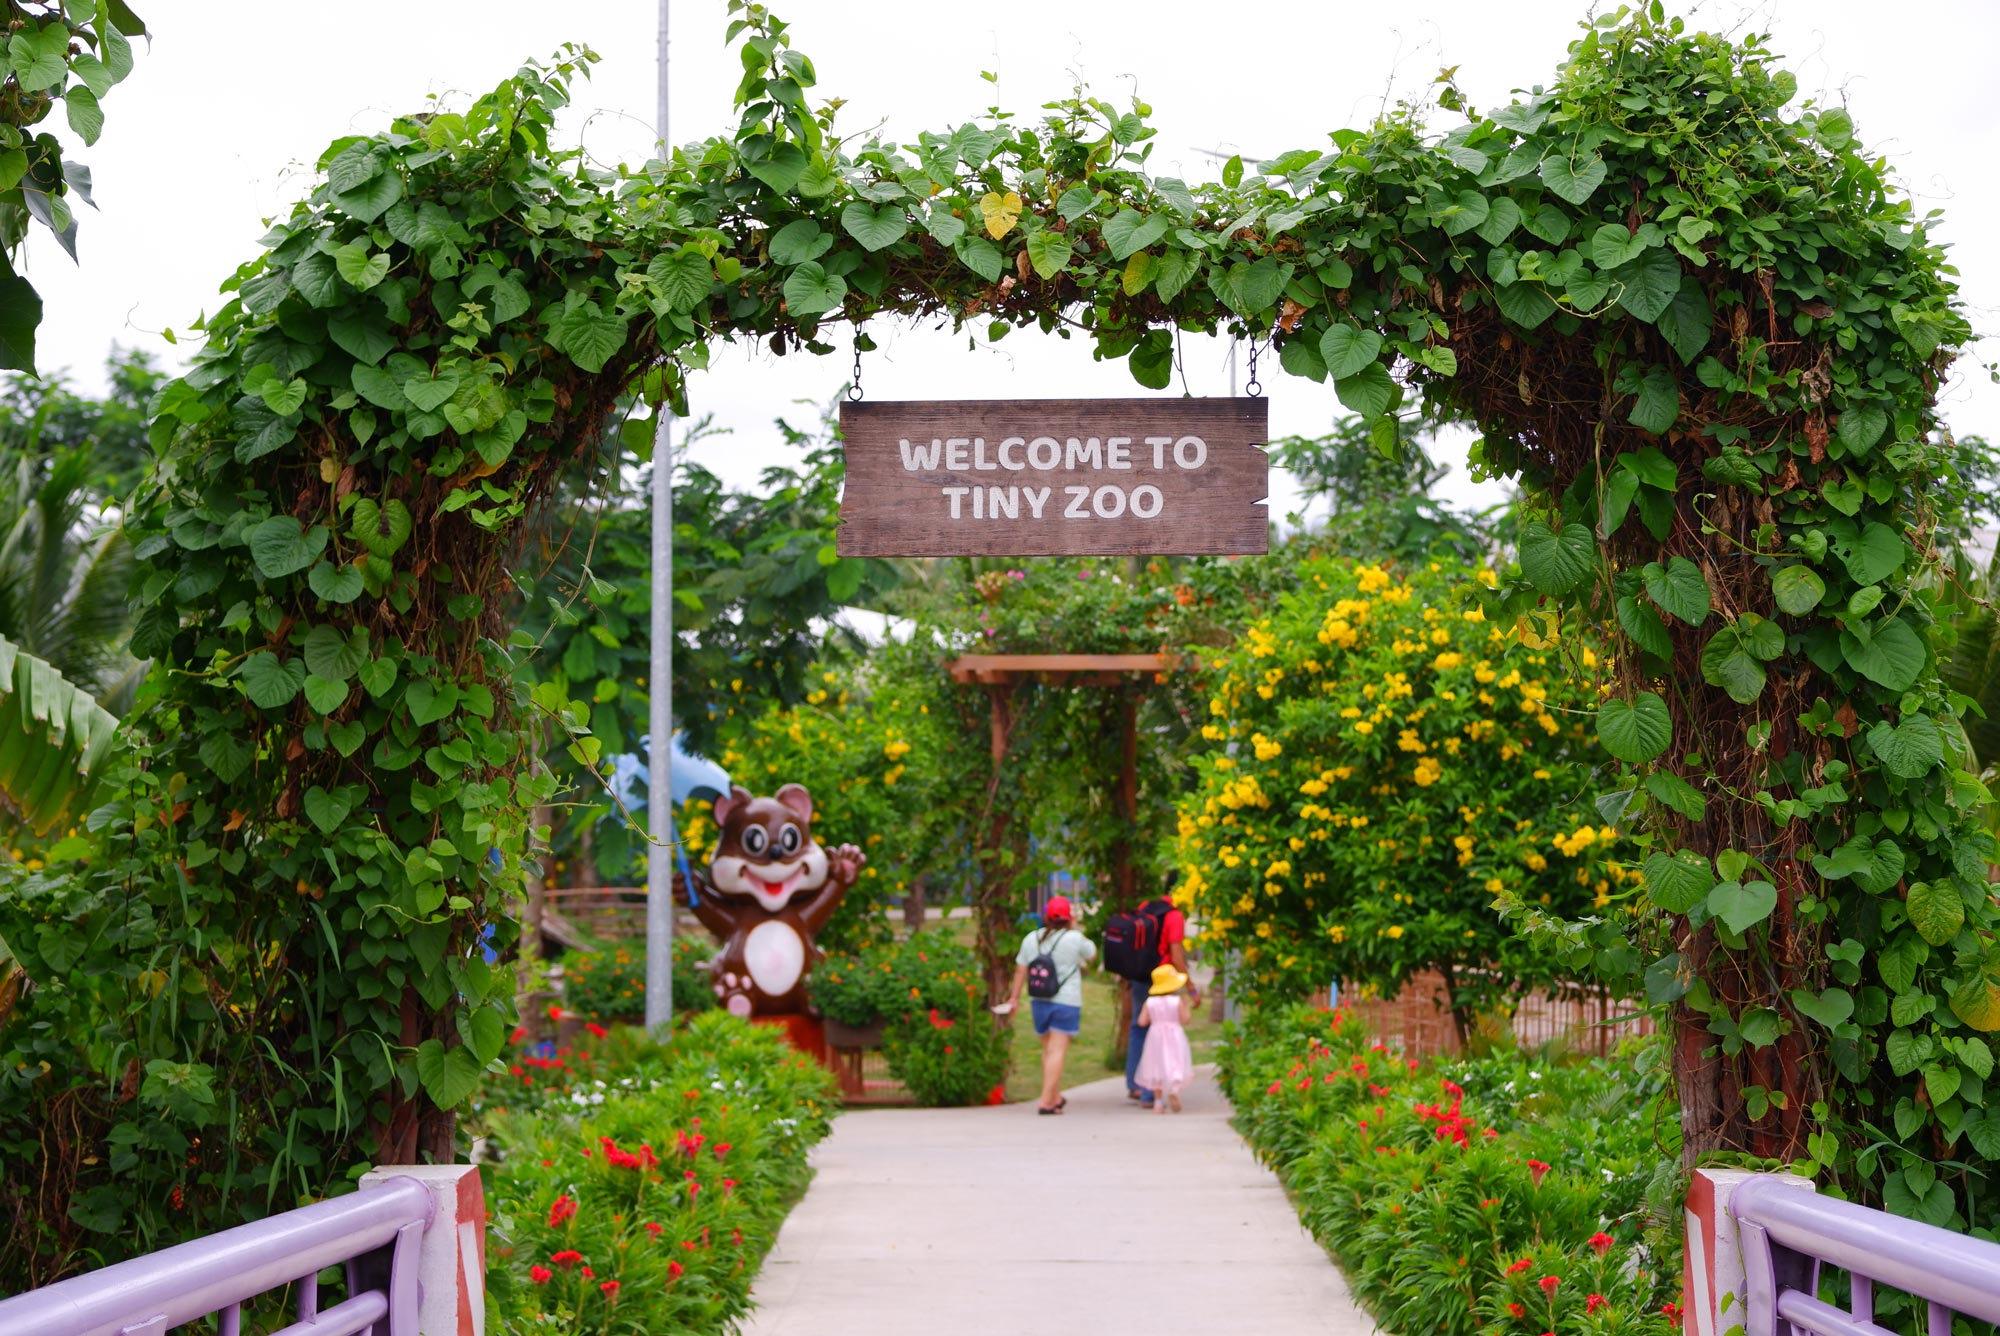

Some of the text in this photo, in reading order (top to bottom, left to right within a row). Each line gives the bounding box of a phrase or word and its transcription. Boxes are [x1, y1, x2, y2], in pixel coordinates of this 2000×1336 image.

[899, 436, 1208, 471] WELCOME TO
[942, 485, 1164, 519] TINY ZOO
